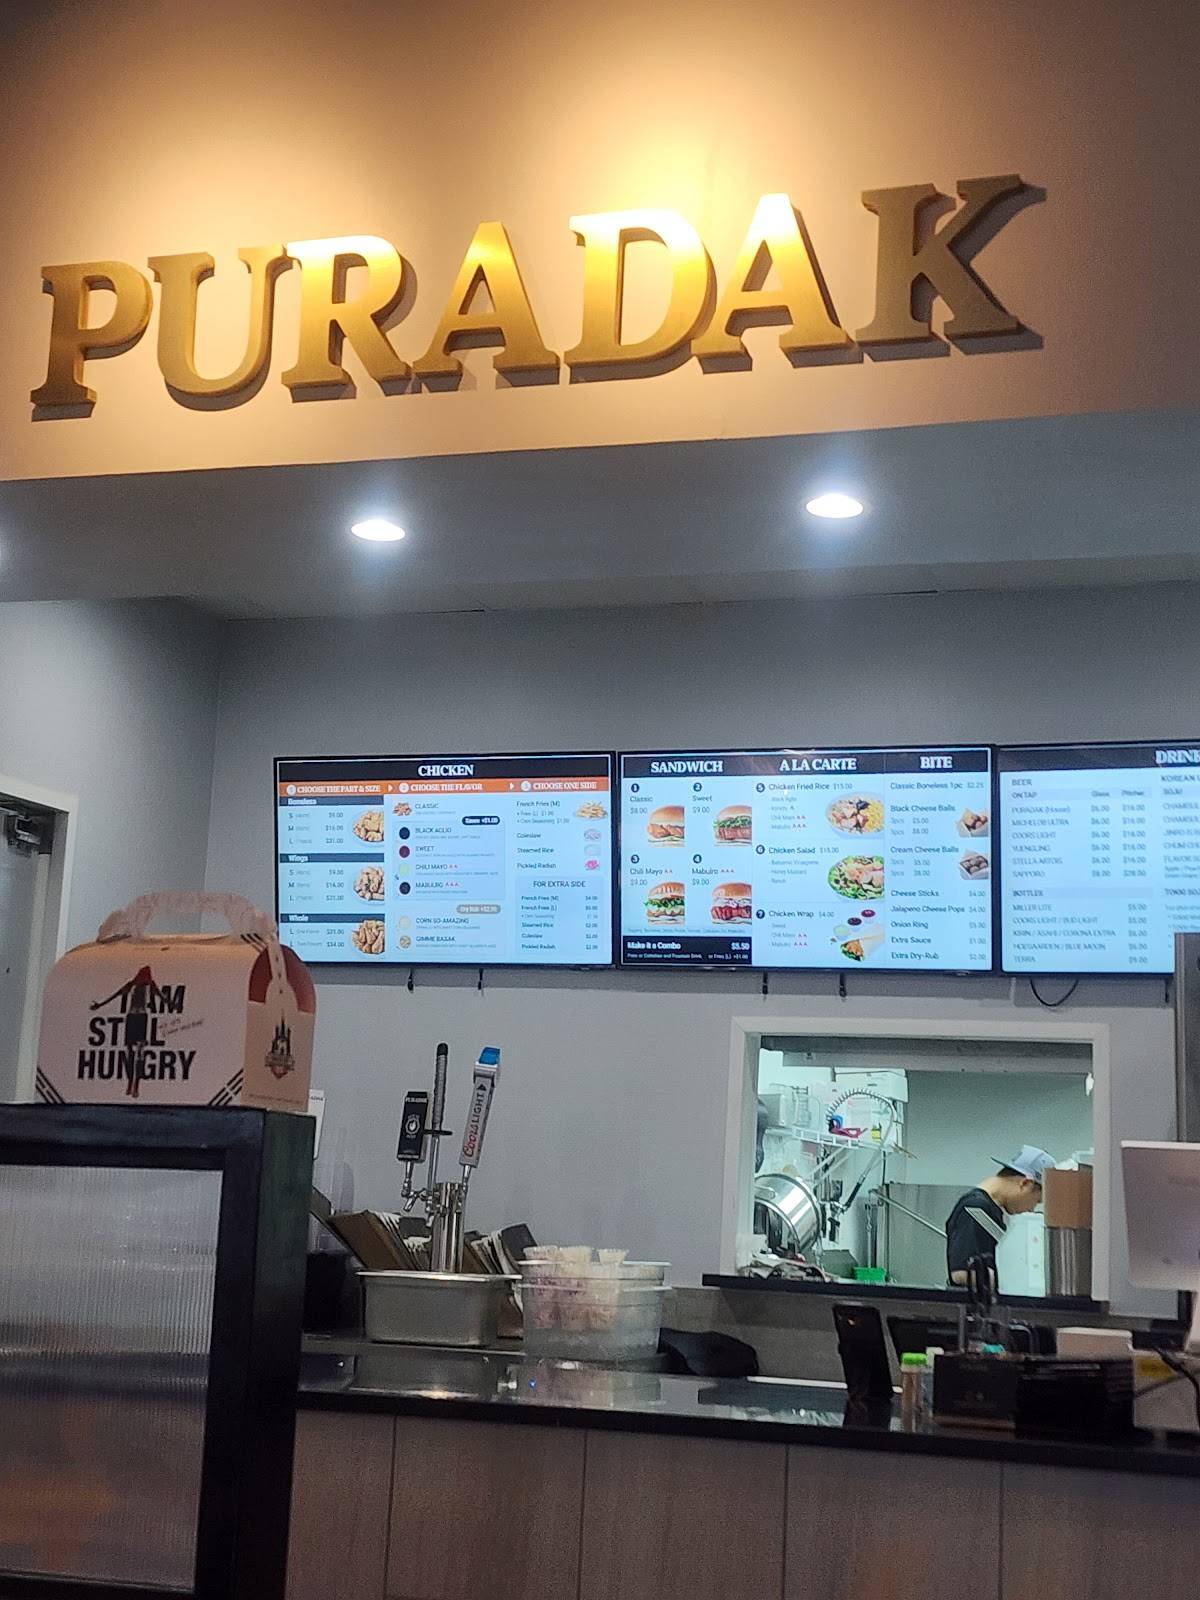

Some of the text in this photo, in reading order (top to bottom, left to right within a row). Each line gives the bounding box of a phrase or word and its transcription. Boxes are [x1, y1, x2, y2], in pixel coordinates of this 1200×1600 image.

[30, 174, 1030, 410] PURADAK
[651, 761, 724, 773] SANDWICH
[792, 759, 810, 771] LA
[812, 758, 857, 771] CARTE
[920, 756, 953, 769] BITE
[418, 765, 474, 776] CHICKEN
[297, 785, 326, 793] CHOOSE
[327, 785, 340, 793] THE
[341, 785, 359, 793] PART
[365, 785, 380, 793] SIZE
[533, 782, 597, 790] CHOOSE ONE SIDE
[646, 868, 663, 876] Mayo
[948, 905, 965, 913] Pops
[913, 921, 929, 929] Ring
[627, 941, 645, 949] Make
[647, 941, 652, 949] it
[657, 941, 681, 949] Combo
[911, 952, 939, 961] Dry-Rub
[88, 1016, 166, 1046] STL
[77, 1050, 197, 1080] HUNGRY
[471, 1093, 485, 1123] LIGHT
